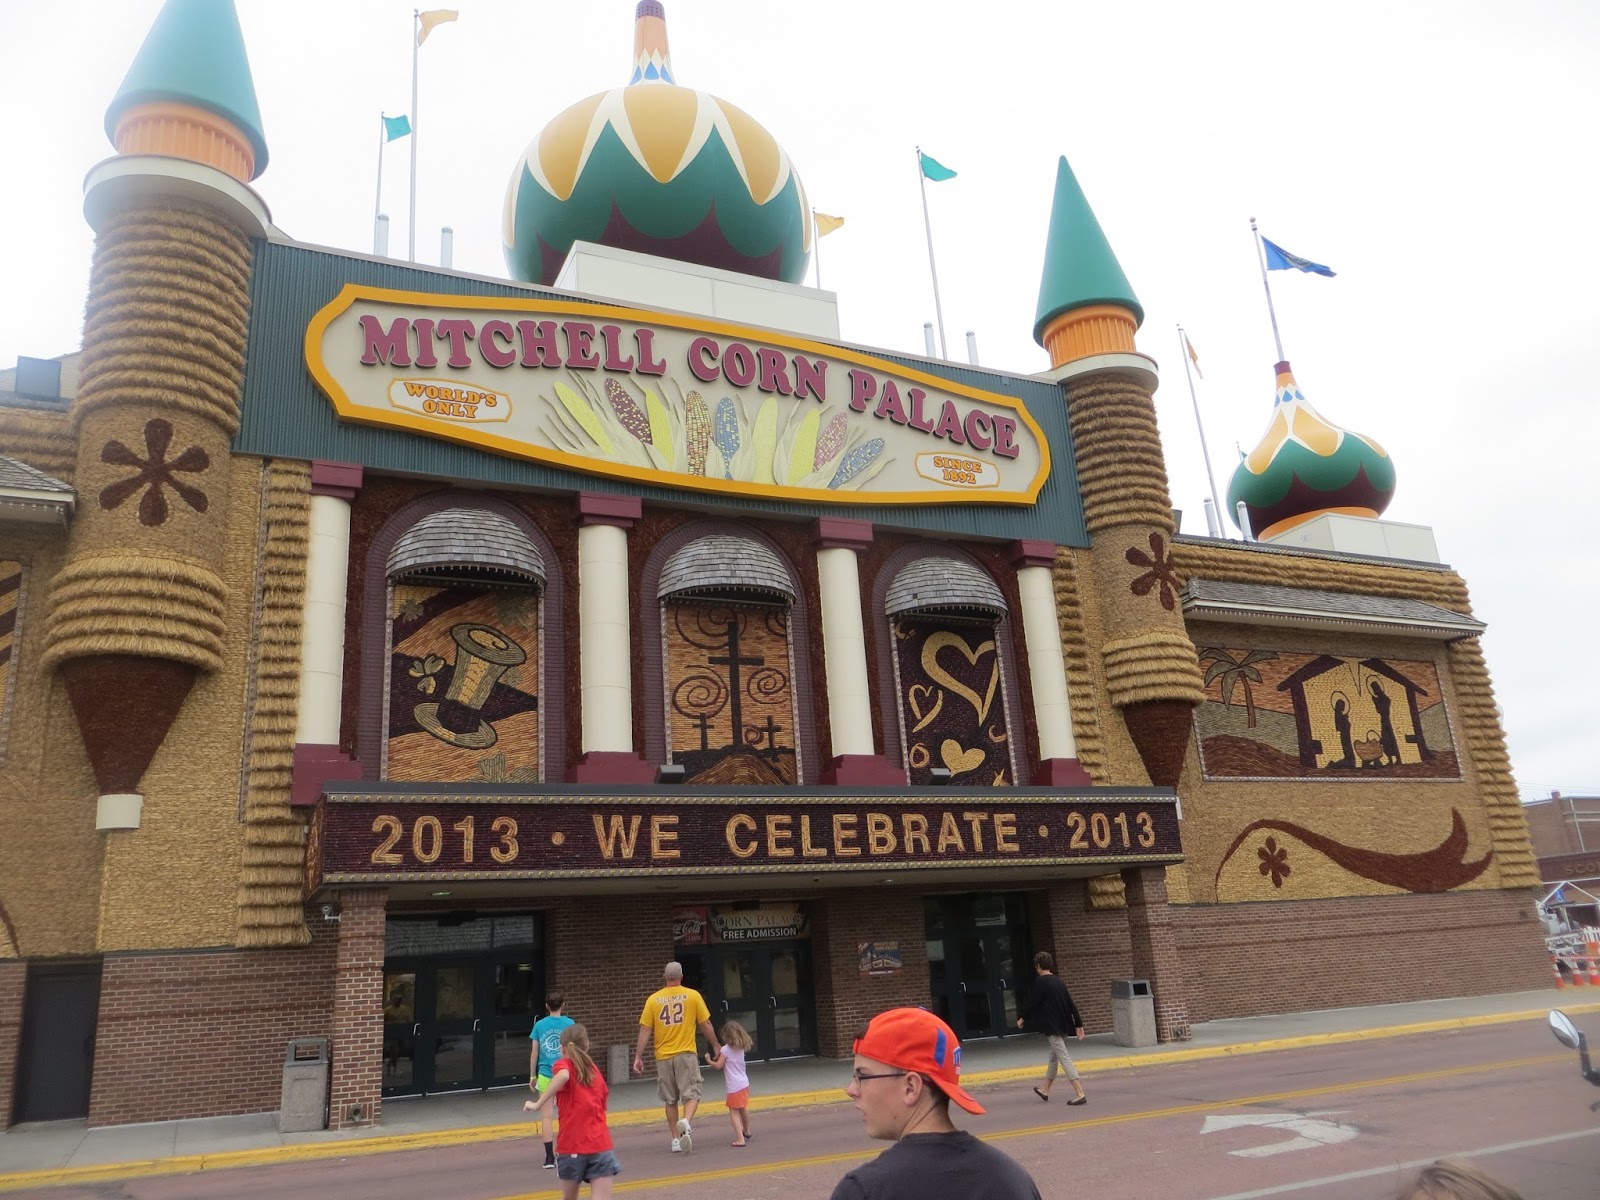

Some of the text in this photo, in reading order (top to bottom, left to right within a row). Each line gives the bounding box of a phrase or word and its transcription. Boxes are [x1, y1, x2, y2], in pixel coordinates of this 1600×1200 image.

[359, 314, 1021, 460] MITCHELL CORN PALACE
[403, 381, 498, 408] WORLD'S
[422, 399, 480, 418] ONLY
[933, 455, 983, 474] SINCE
[942, 469, 977, 484] 1892
[371, 814, 520, 864] 2013
[593, 814, 681, 859] WE
[725, 811, 1020, 857] CELEBRATE
[1067, 811, 1156, 849] 2013
[715, 914, 752, 928] CORN
[723, 927, 797, 940] FREE ADMISSION
[659, 1002, 684, 1027] 42
